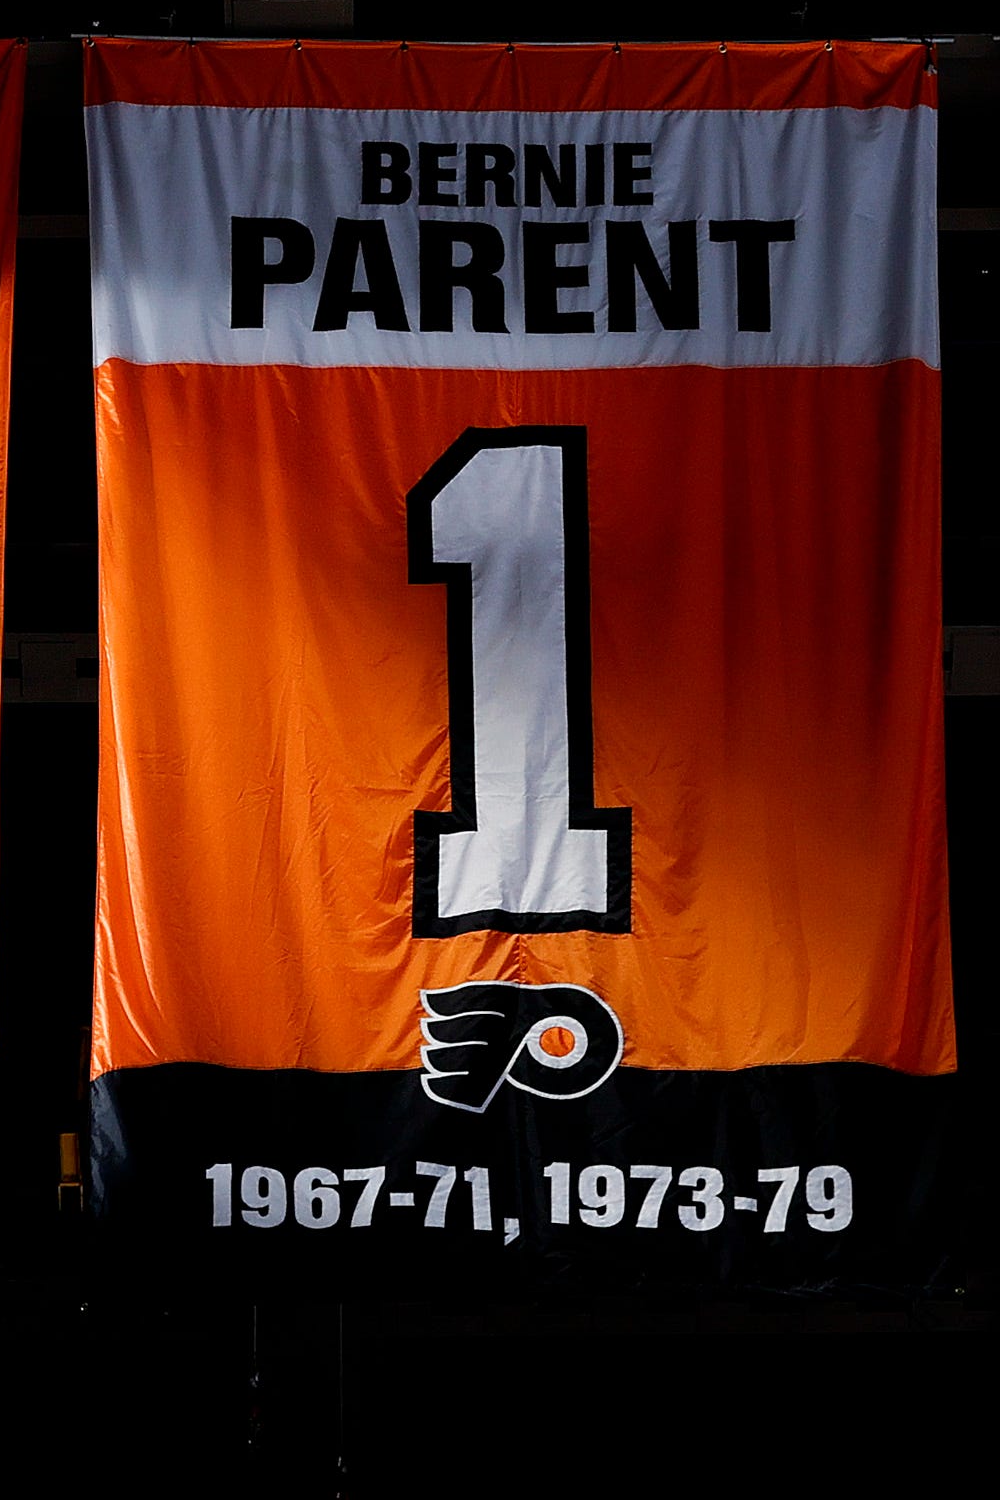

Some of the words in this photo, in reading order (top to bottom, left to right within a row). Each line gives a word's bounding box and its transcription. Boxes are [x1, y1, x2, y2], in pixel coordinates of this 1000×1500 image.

[360, 140, 655, 209] BERNIE
[229, 215, 796, 335] PARENT
[406, 424, 633, 939] 1
[204, 1160, 522, 1247] 1967-71,
[543, 1161, 855, 1234] 1973-79
